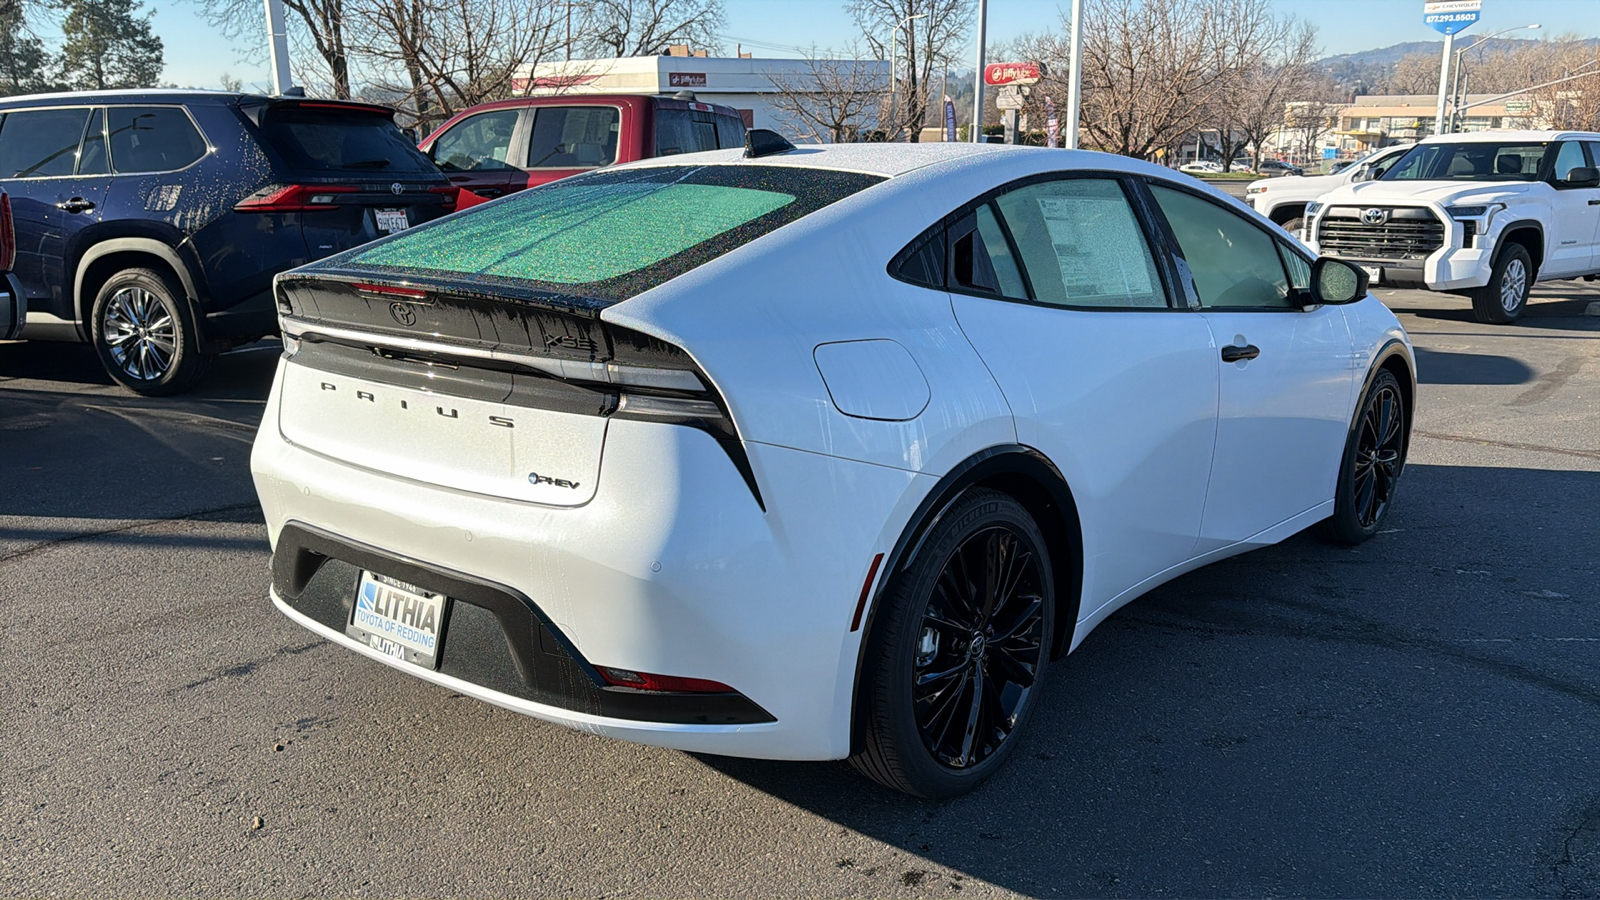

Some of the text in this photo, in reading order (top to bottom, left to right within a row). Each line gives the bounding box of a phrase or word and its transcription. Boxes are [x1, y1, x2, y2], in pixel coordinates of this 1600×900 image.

[545, 333, 594, 350] XSE
[321, 382, 515, 429] PRIUS
[538, 475, 581, 490] PHEV
[951, 503, 998, 536] MICHELIN
[375, 587, 435, 634] LITHIA
[357, 610, 434, 648] TOYOTA OF REDDING
[377, 637, 405, 660] LITHIA
